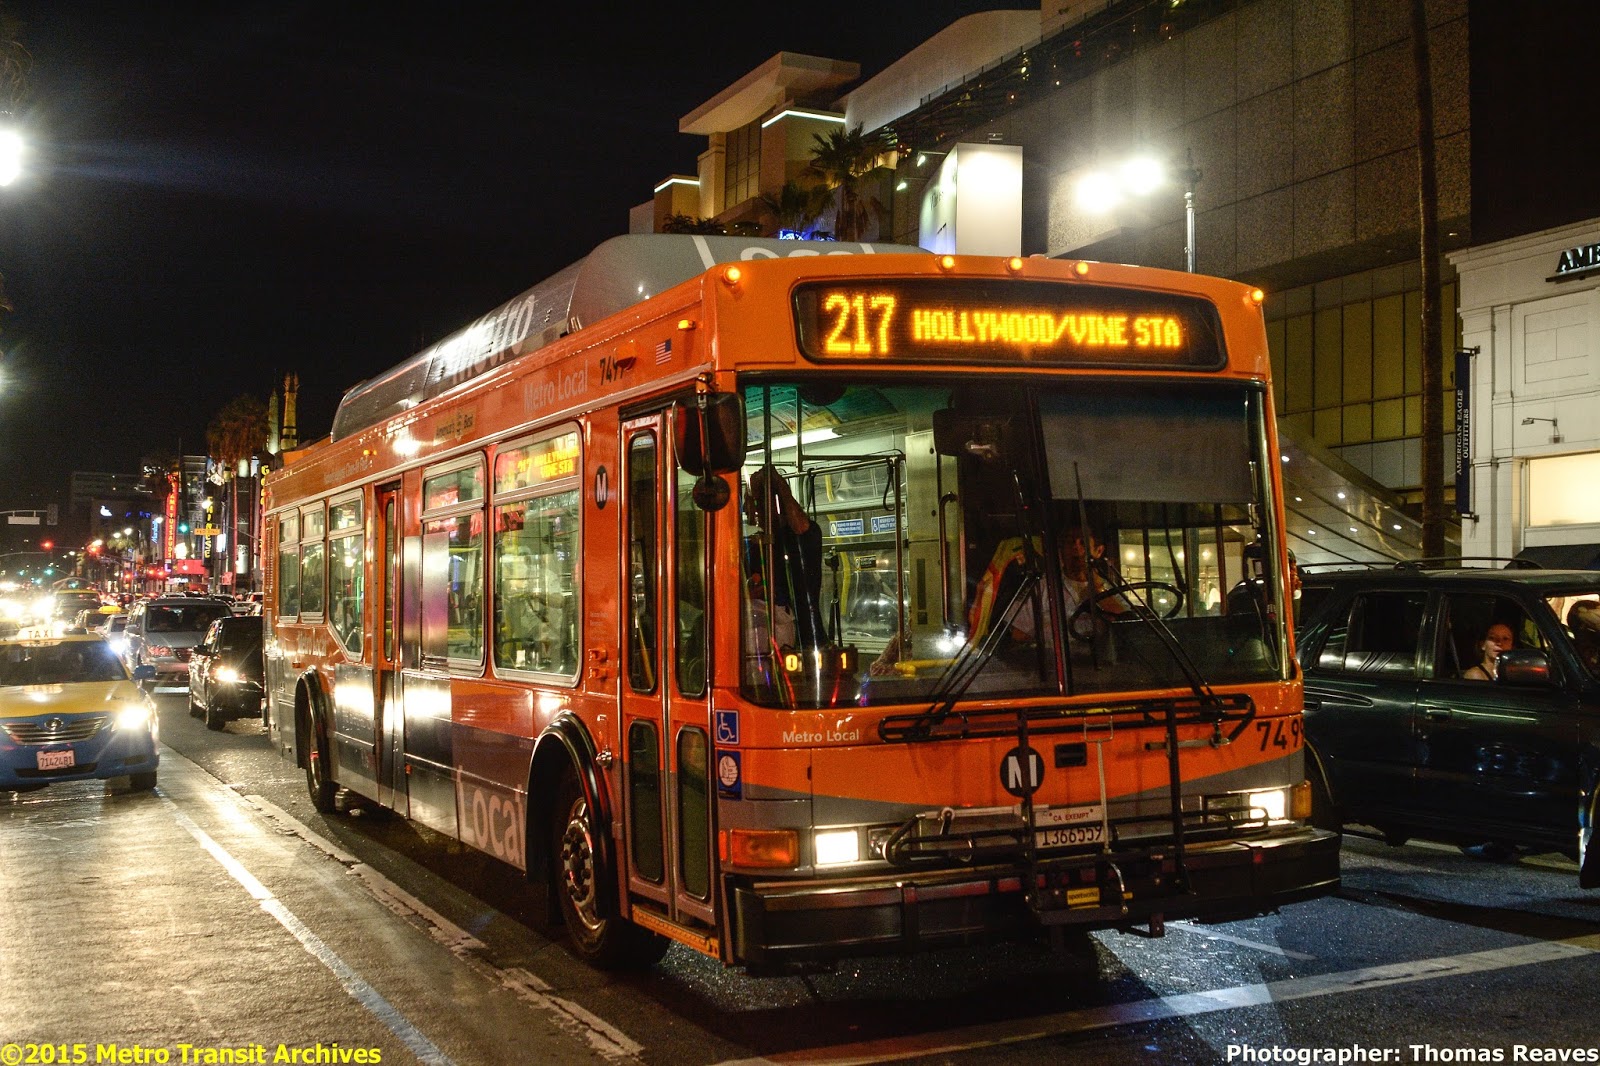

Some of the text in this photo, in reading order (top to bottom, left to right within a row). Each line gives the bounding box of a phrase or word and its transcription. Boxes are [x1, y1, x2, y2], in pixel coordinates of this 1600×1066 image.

[824, 293, 1181, 354] 217 HOLLYWOOD/VINE STA
[524, 360, 589, 414] Metro Local
[28, 629, 54, 639] TAXI
[783, 729, 860, 743] Metro Local
[456, 765, 527, 868] Local
[1065, 812, 1090, 821] EXEMPT
